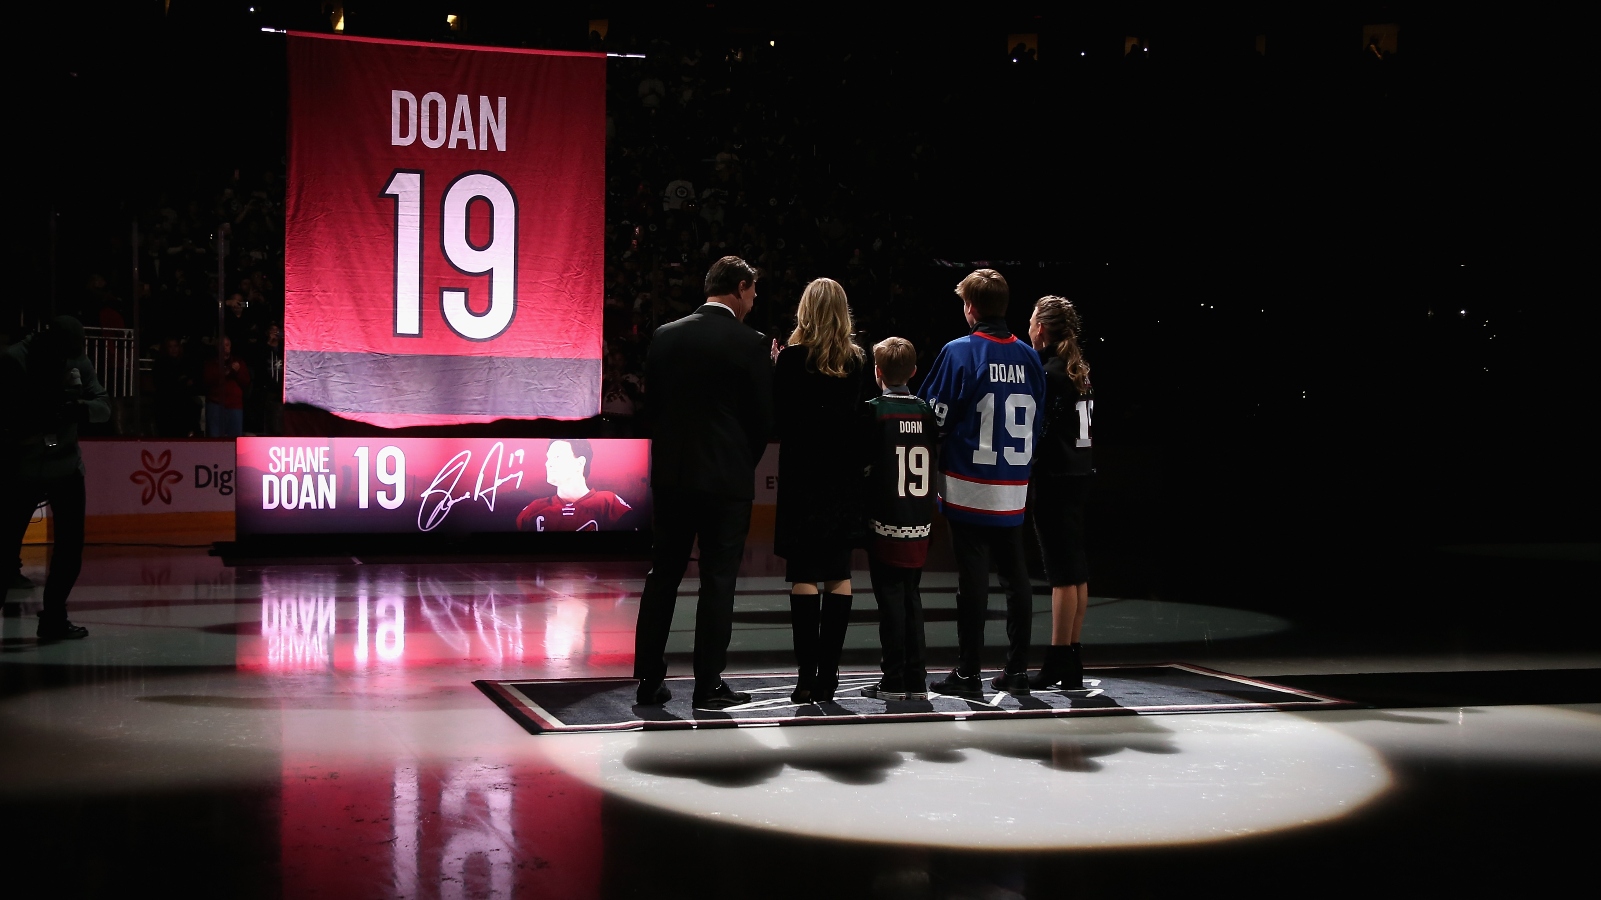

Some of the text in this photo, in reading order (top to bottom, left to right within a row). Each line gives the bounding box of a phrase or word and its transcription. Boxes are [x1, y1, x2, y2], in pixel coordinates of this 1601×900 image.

[391, 89, 507, 152] DOAN
[380, 169, 519, 342] 19
[988, 363, 1026, 384] DOAN
[899, 420, 923, 434] DOAN
[972, 392, 1037, 466] 19
[1075, 399, 1094, 448] 1
[194, 464, 234, 496] Dig
[268, 446, 330, 474] SHANE
[353, 445, 407, 510] 19
[895, 446, 930, 497] 19
[262, 474, 337, 510] DOAN
[535, 515, 545, 532] C
